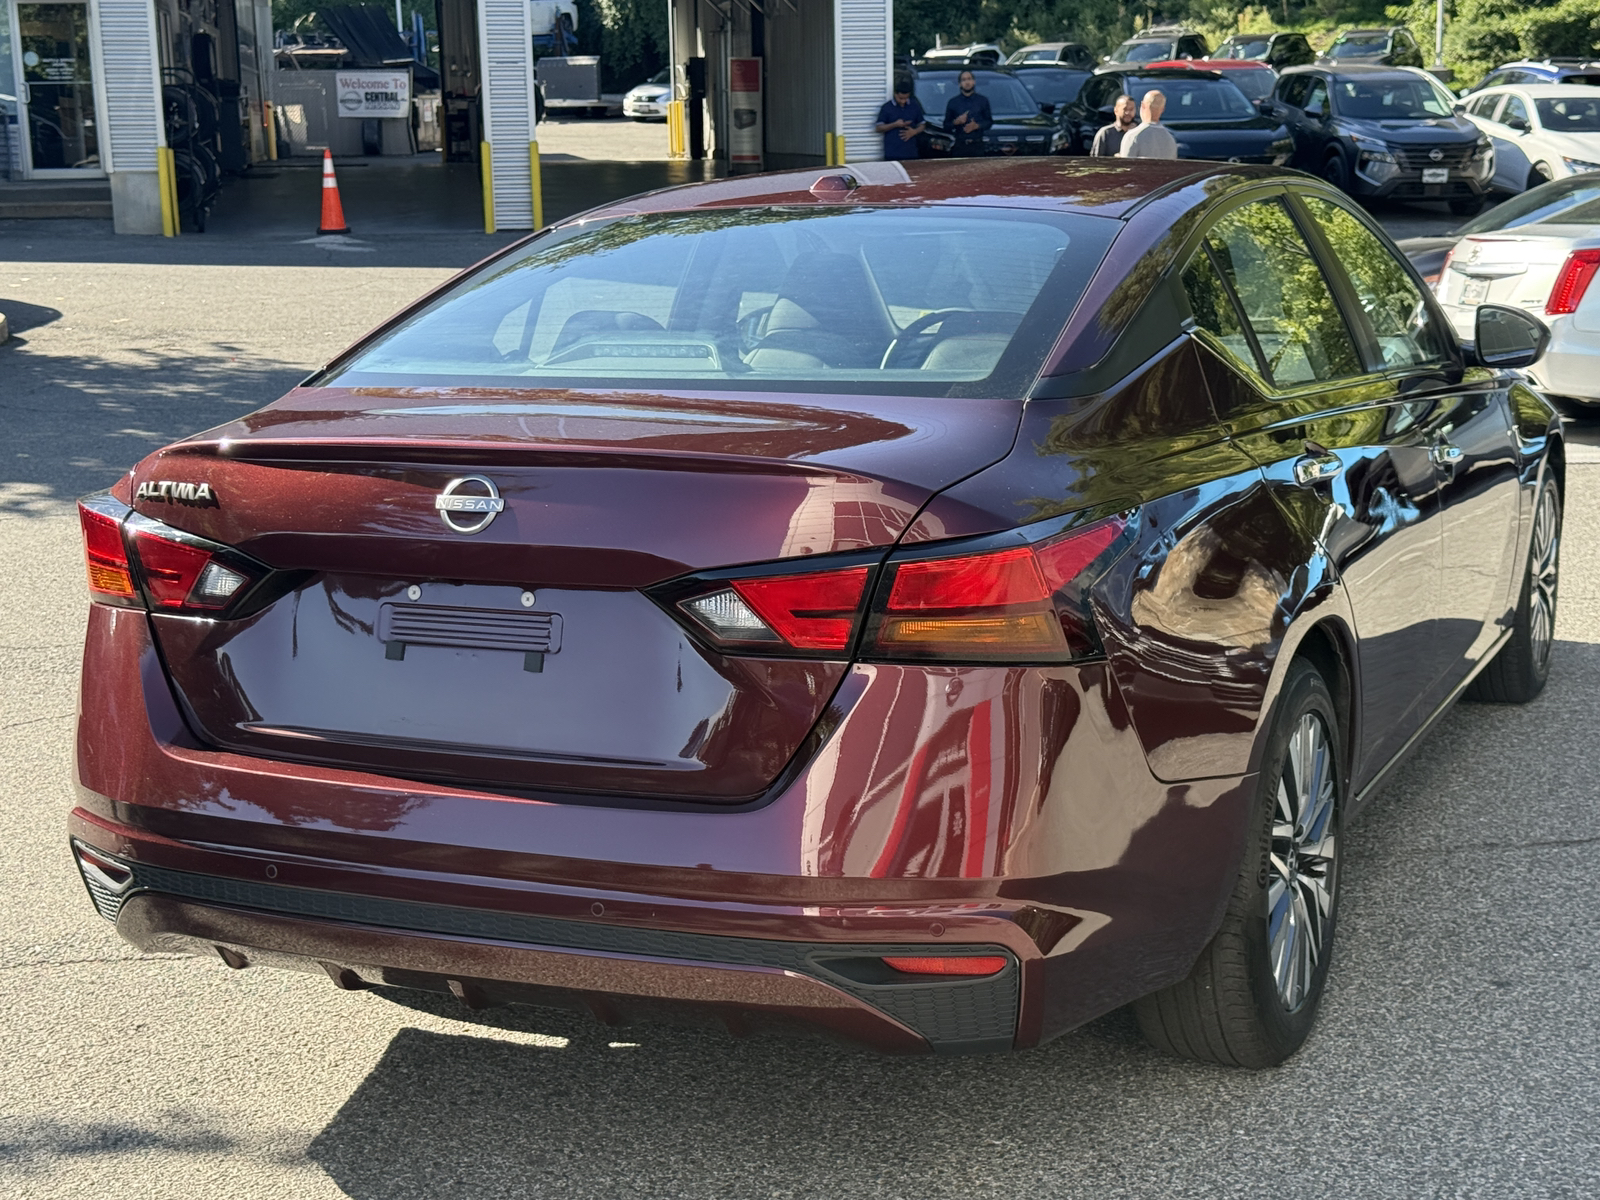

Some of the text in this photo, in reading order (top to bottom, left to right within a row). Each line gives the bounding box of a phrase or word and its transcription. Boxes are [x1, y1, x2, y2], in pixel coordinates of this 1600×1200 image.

[339, 78, 407, 90] Welcome To
[364, 91, 399, 102] CENTRAL
[136, 481, 212, 500] ALTIMA
[436, 498, 502, 510] NISSAN
